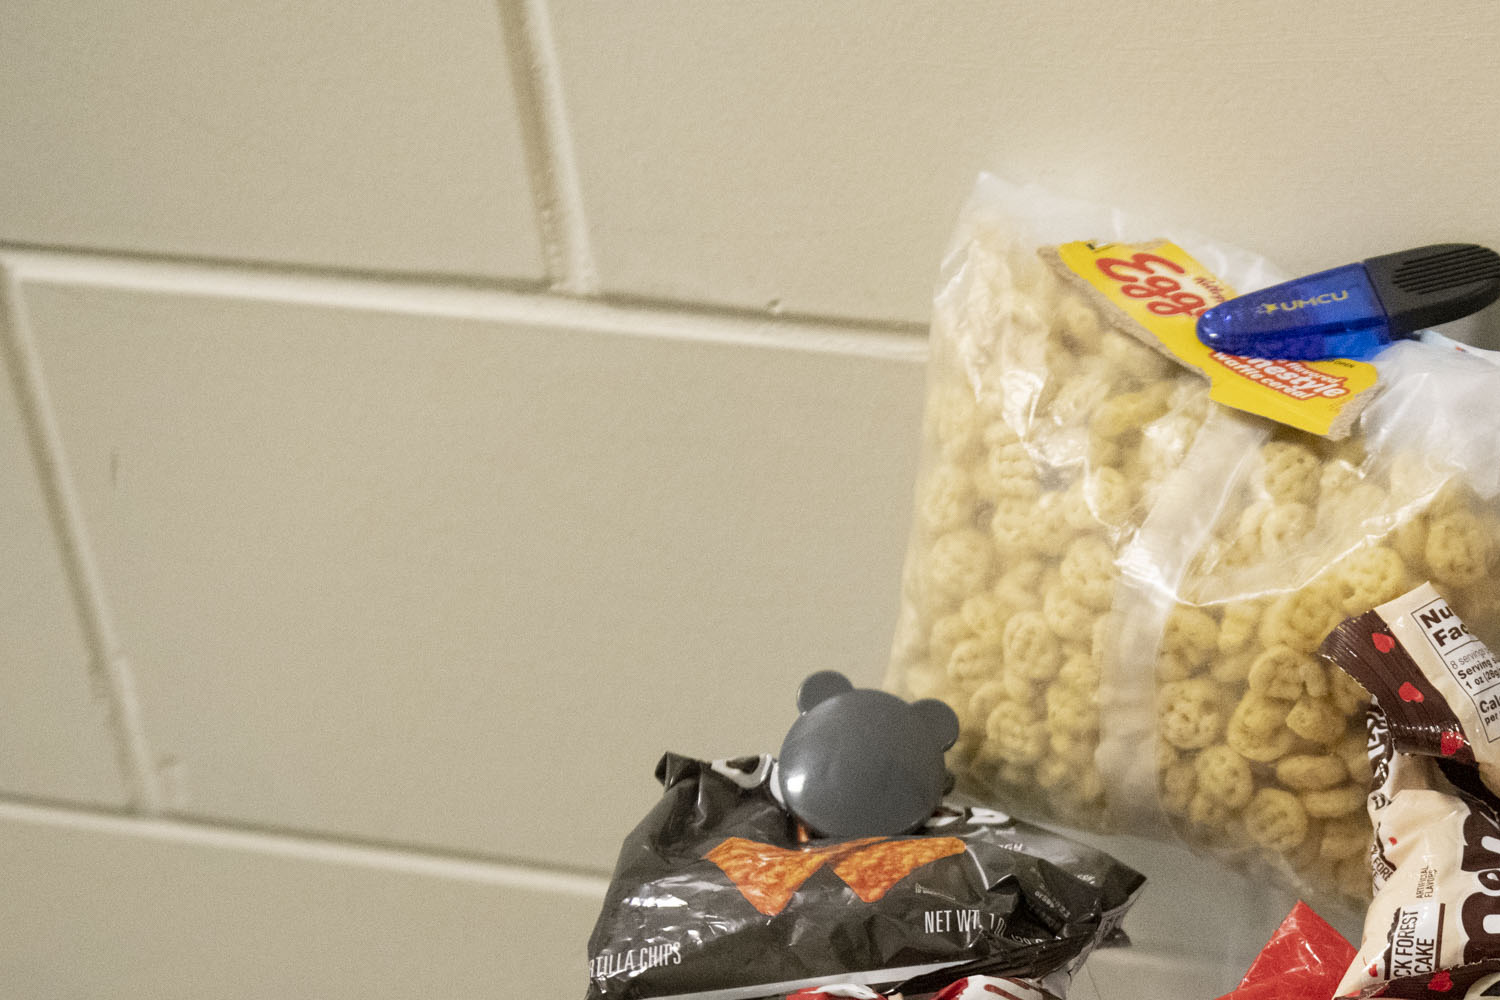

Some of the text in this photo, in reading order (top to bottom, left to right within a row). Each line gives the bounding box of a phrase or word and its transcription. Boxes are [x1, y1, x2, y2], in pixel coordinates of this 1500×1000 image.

[1096, 253, 1206, 317] Egg
[1280, 290, 1349, 312] UMCU
[1432, 623, 1469, 647] Fac
[1457, 659, 1493, 680] Serving
[1474, 677, 1485, 686] oz
[1484, 712, 1499, 726] per
[925, 911, 952, 934] NET
[1401, 910, 1420, 956] FOREST
[589, 941, 682, 978] RTILLA CHIPS
[1414, 938, 1435, 974] CAKE
